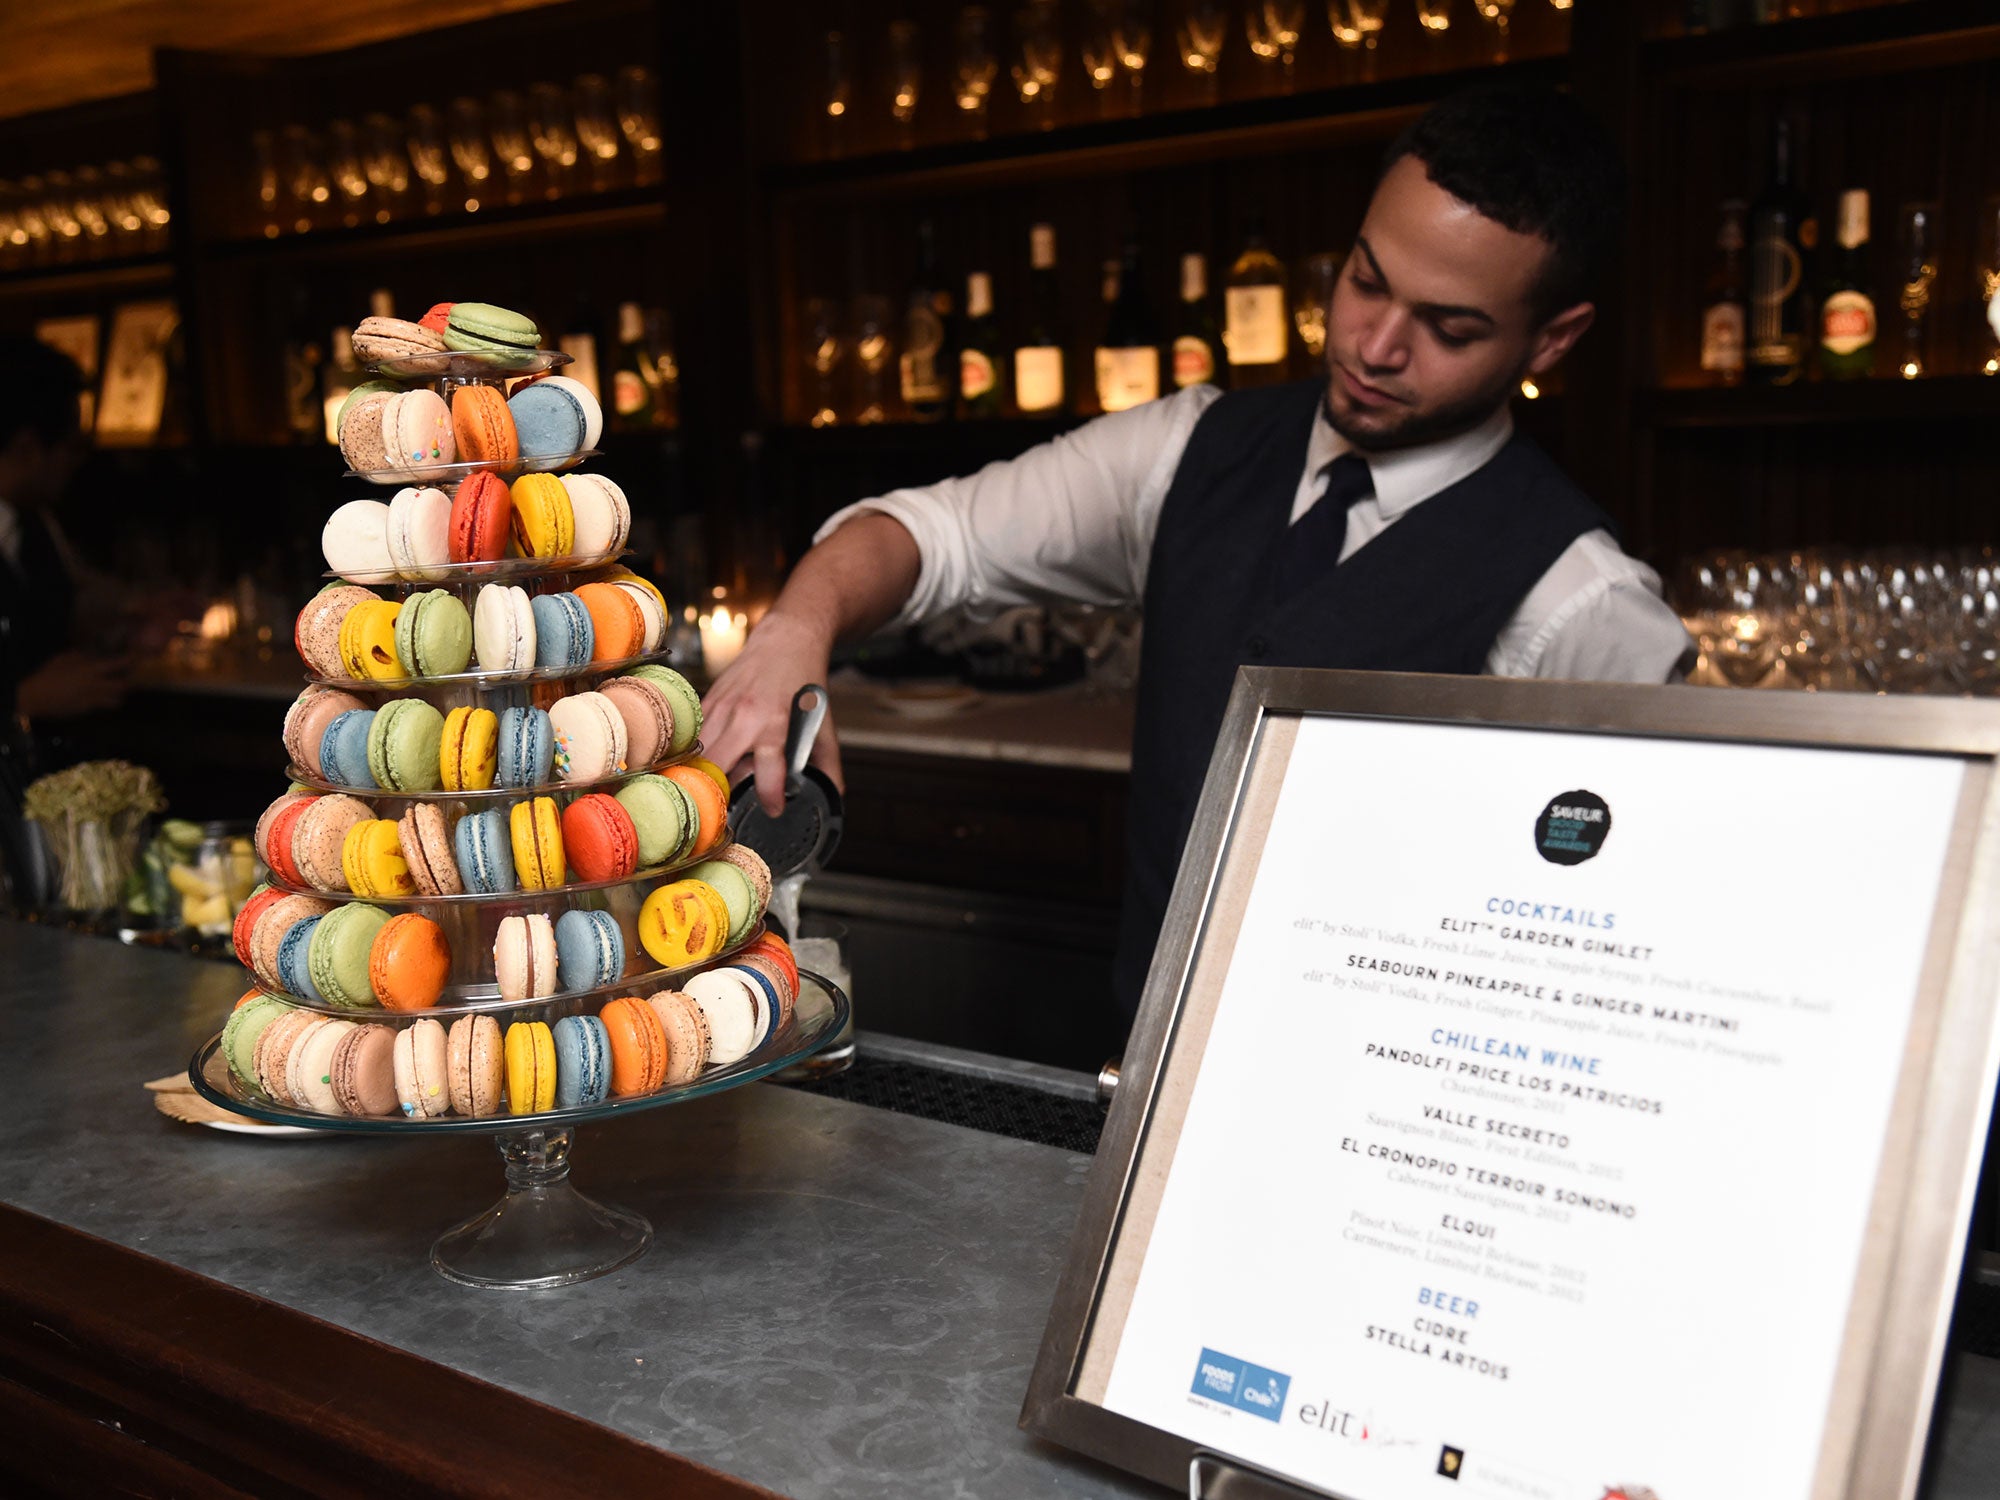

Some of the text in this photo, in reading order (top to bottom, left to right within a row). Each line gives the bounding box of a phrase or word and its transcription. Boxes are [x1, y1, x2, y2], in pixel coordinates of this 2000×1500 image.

[1550, 804, 1603, 823] SAVEUR
[1486, 897, 1616, 930] COCKTAILS
[1422, 936, 1459, 953] Fresh
[1463, 943, 1497, 961] Lime
[1499, 926, 1575, 949] GARDEN
[1582, 938, 1653, 961] GIMLET
[1347, 954, 1740, 1033] SEABOURN PINEAPPLE & GINGER MARTINI
[1433, 991, 1472, 1010] Fresh
[1529, 1008, 1601, 1034] Pineapple
[1431, 1028, 1602, 1076] CHILEAN WINE
[1365, 1042, 1664, 1116] PANDOLFI PRICE LOS PATRICIOS
[1423, 1104, 1570, 1149] VALLE SECRETO
[1340, 1137, 1637, 1220] EL CRONOPIO TERROIR SONONO
[1349, 1209, 1387, 1231] Pinot
[1441, 1213, 1497, 1240] ELQUI
[1417, 1286, 1481, 1319] BEER
[1413, 1316, 1469, 1346] CIDRE
[1365, 1325, 1511, 1381] STELLA ARTOIS
[1299, 1399, 1354, 1437] elit
